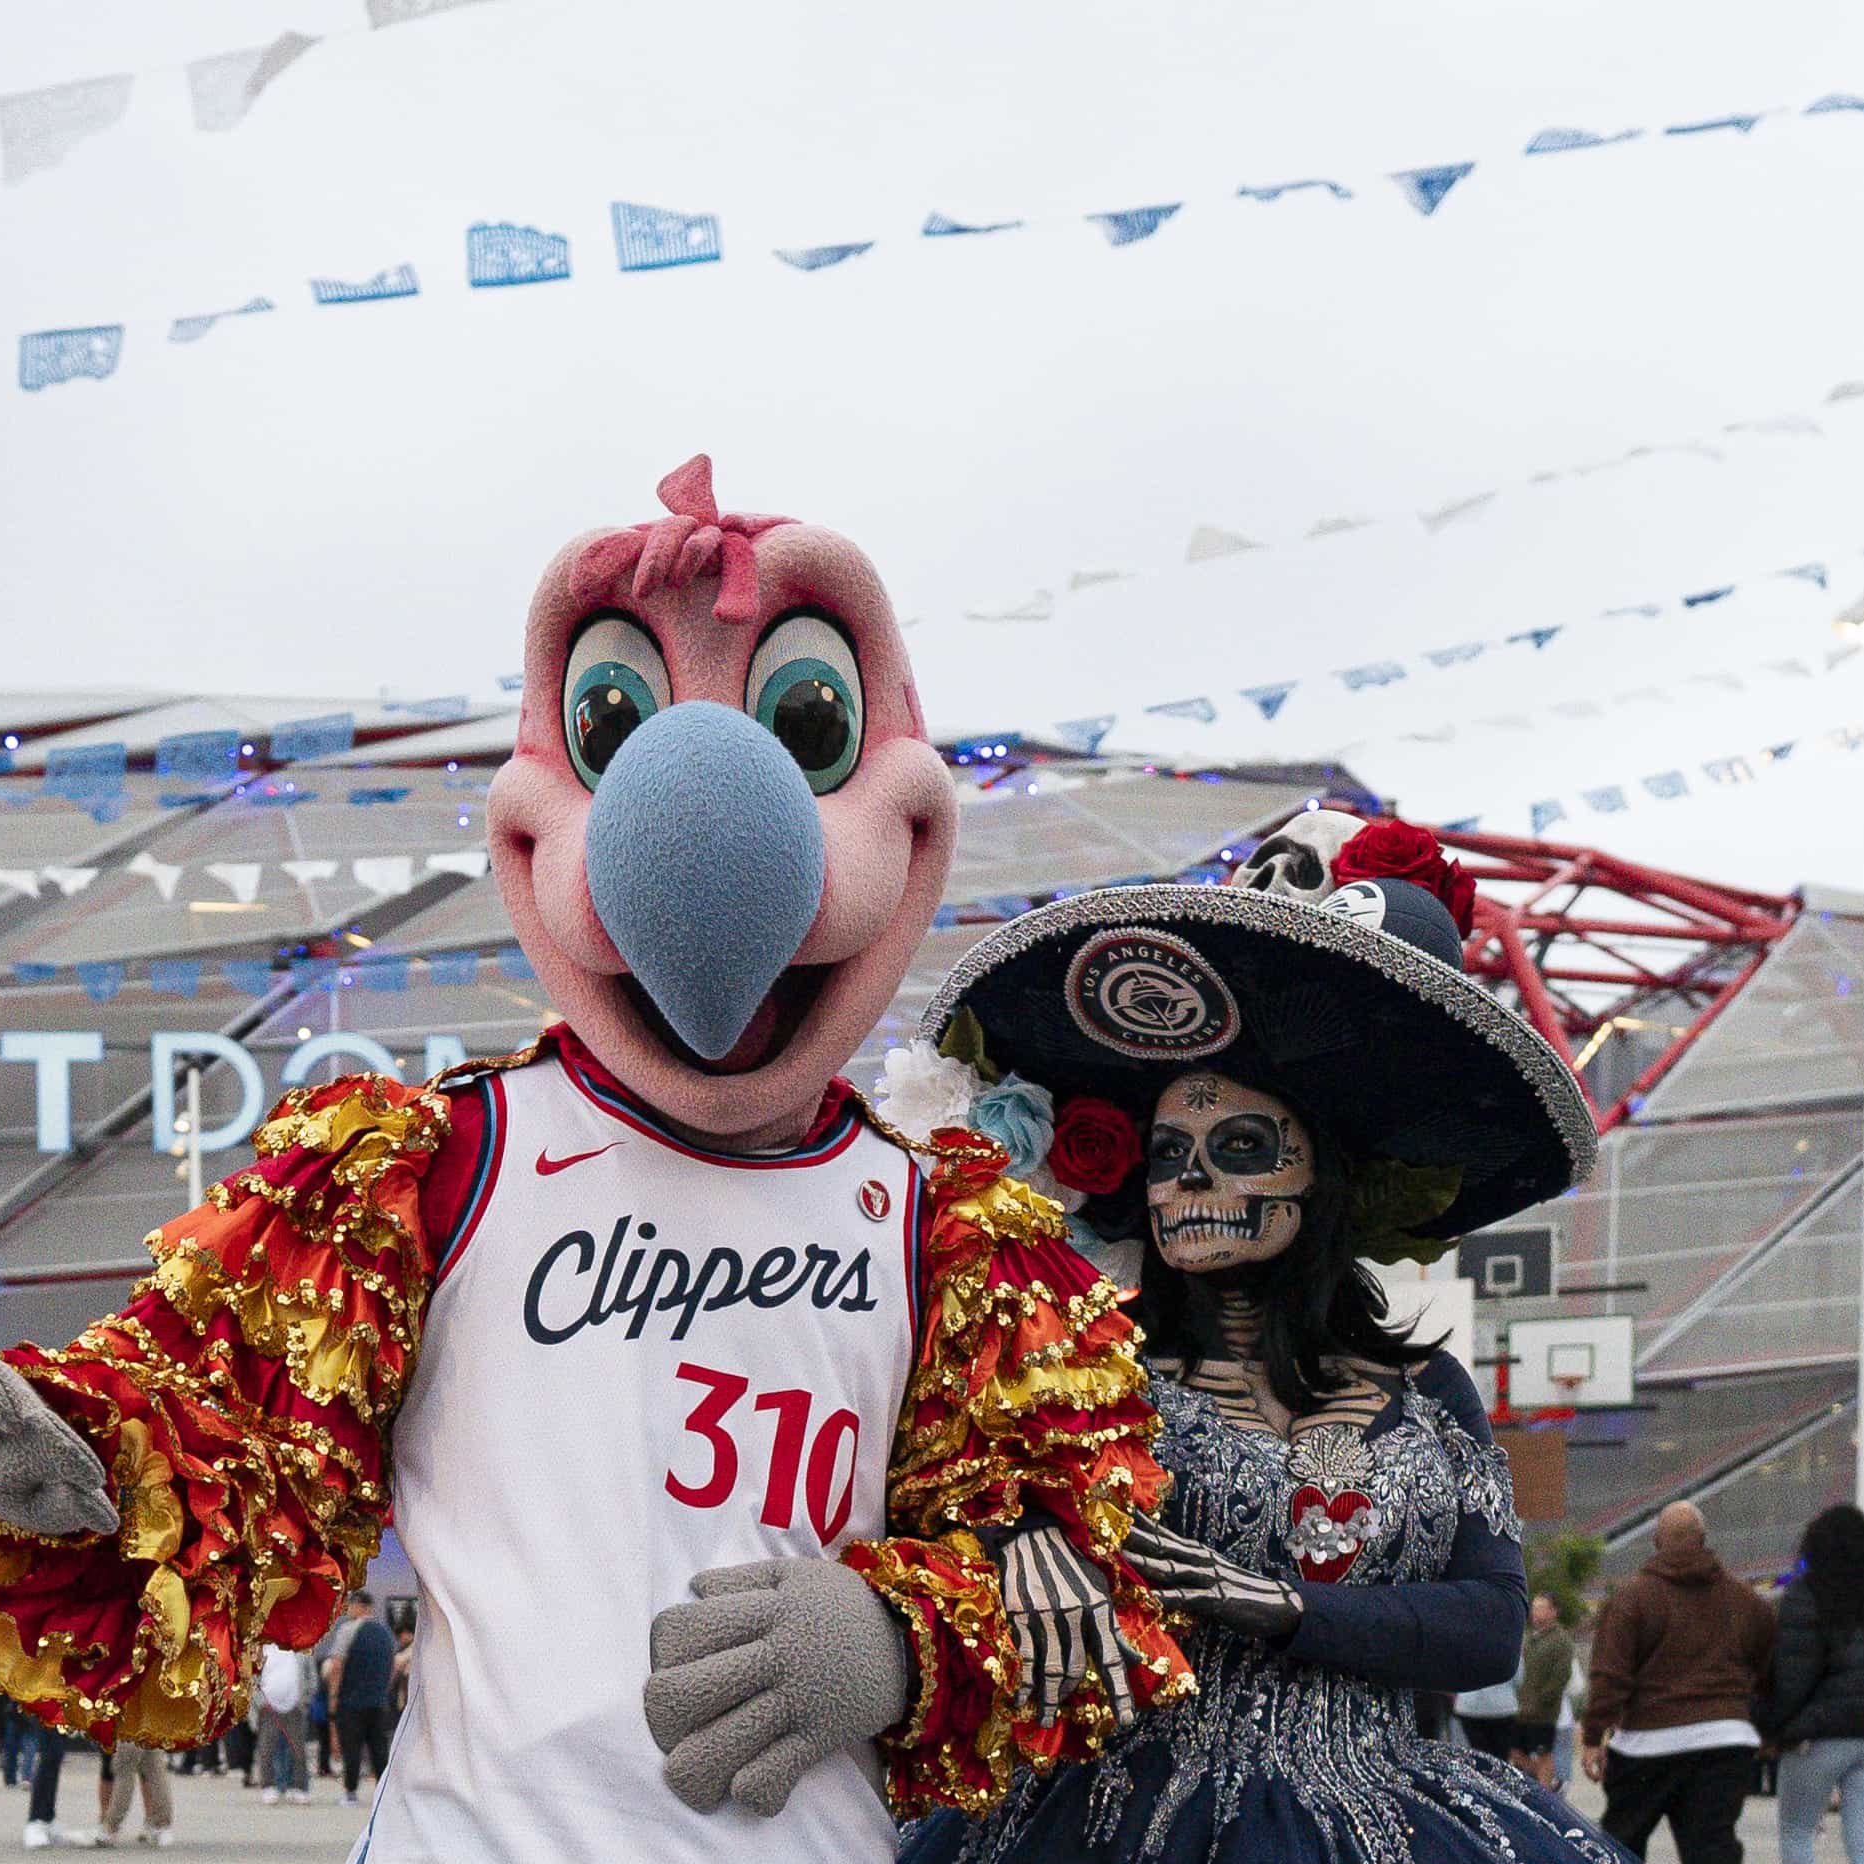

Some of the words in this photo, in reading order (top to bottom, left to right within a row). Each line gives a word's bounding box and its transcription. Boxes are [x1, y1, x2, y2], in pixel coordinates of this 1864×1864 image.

[1084, 967, 1101, 998] LOS
[1107, 945, 1204, 984] ANGELES
[523, 1214, 879, 1346] Clippers
[664, 1361, 861, 1549] 310
